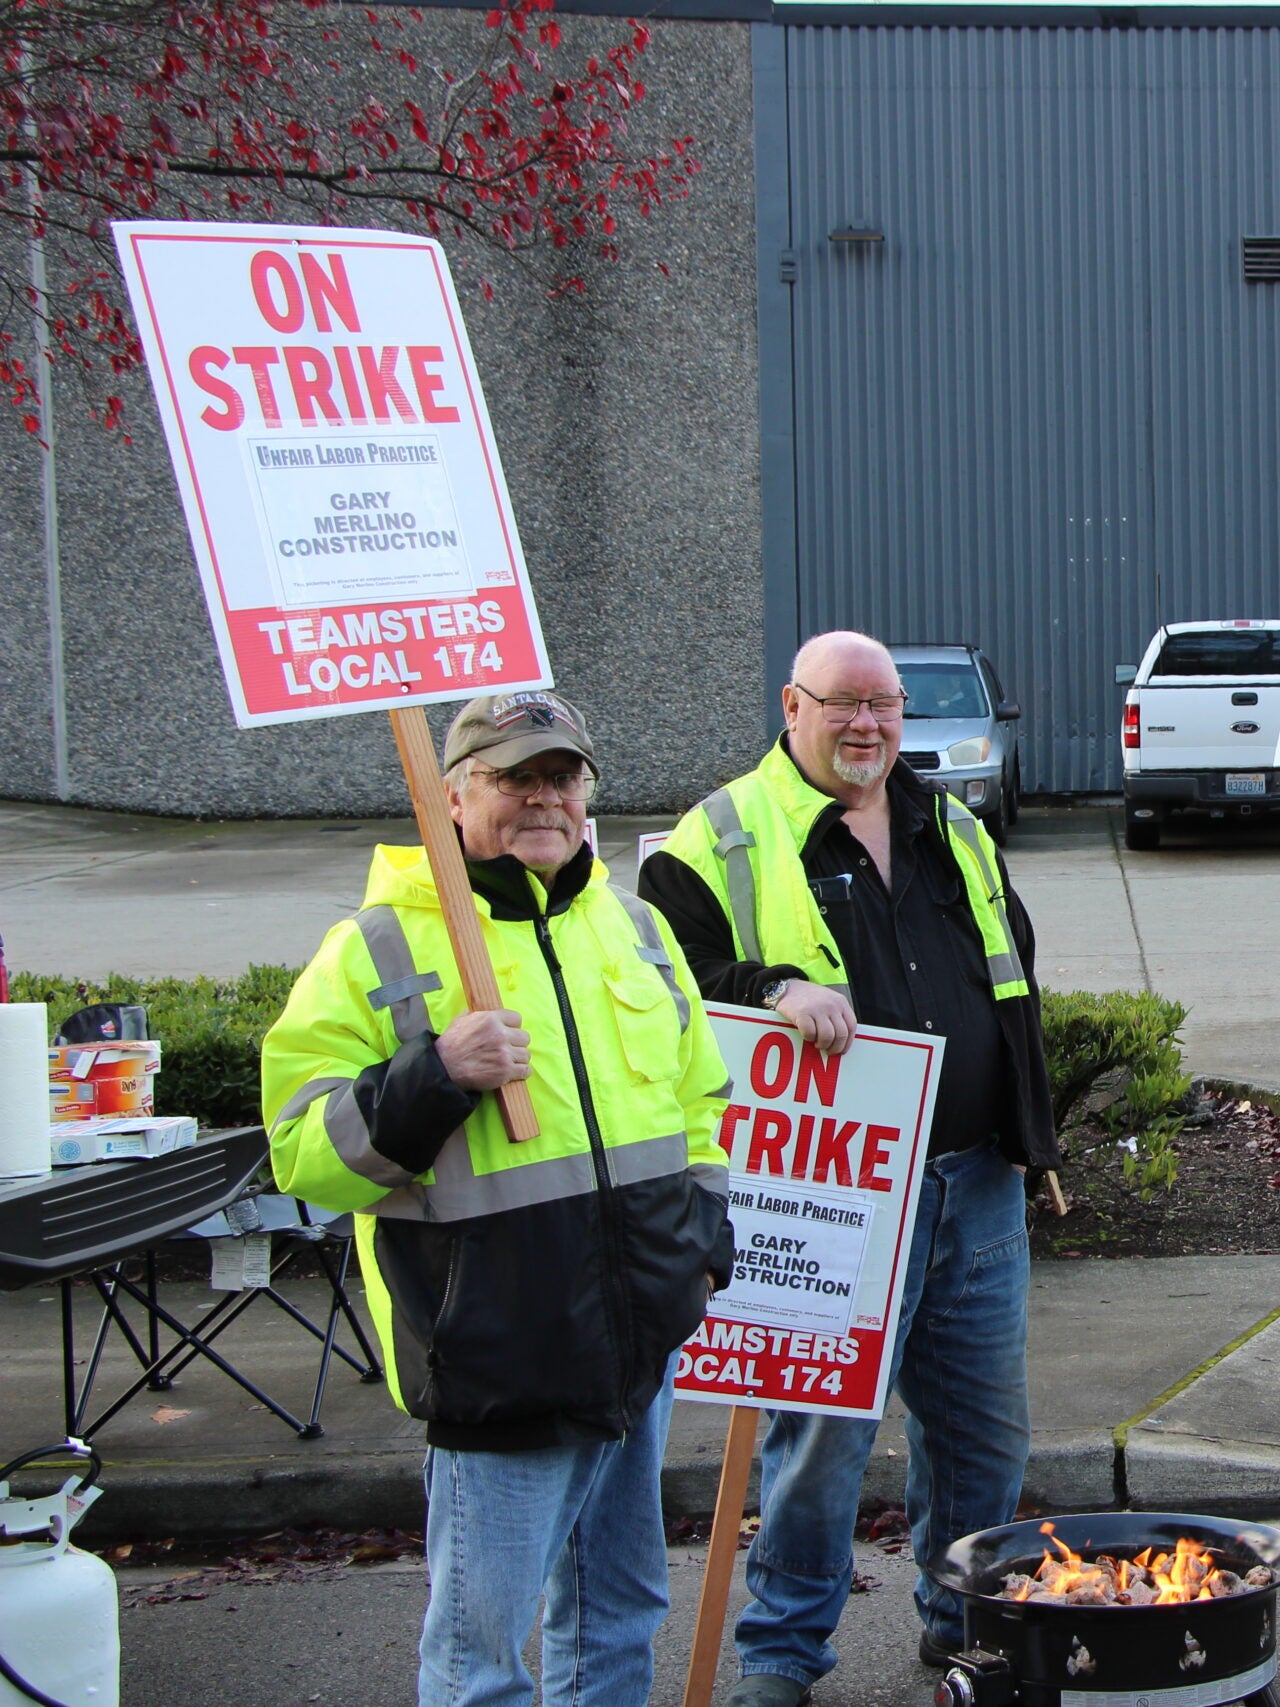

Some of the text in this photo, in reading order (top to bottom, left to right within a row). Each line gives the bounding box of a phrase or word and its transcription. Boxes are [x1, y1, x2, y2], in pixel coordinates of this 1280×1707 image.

[250, 249, 361, 333] ON
[188, 345, 461, 432] STRIKE
[256, 442, 437, 468] UNFAIR LABOR PRACTICE
[329, 491, 391, 512] GARY
[314, 511, 416, 535] MERLINO
[279, 530, 458, 558] CONSTRUCTION
[259, 601, 505, 655] TEAMSTERS
[282, 642, 504, 696] LOCAL 174
[493, 693, 535, 716] SANTA
[750, 1031, 841, 1107] ON
[719, 1104, 900, 1192] TRIKE
[729, 1191, 865, 1227] FAIR LABOR PRACTICE
[733, 1248, 820, 1275] MERLINO
[751, 1233, 807, 1254] GARY
[734, 1266, 851, 1298] STRUCTION
[684, 1321, 860, 1365] AMSTERS
[675, 1351, 842, 1396] OCAL 174
